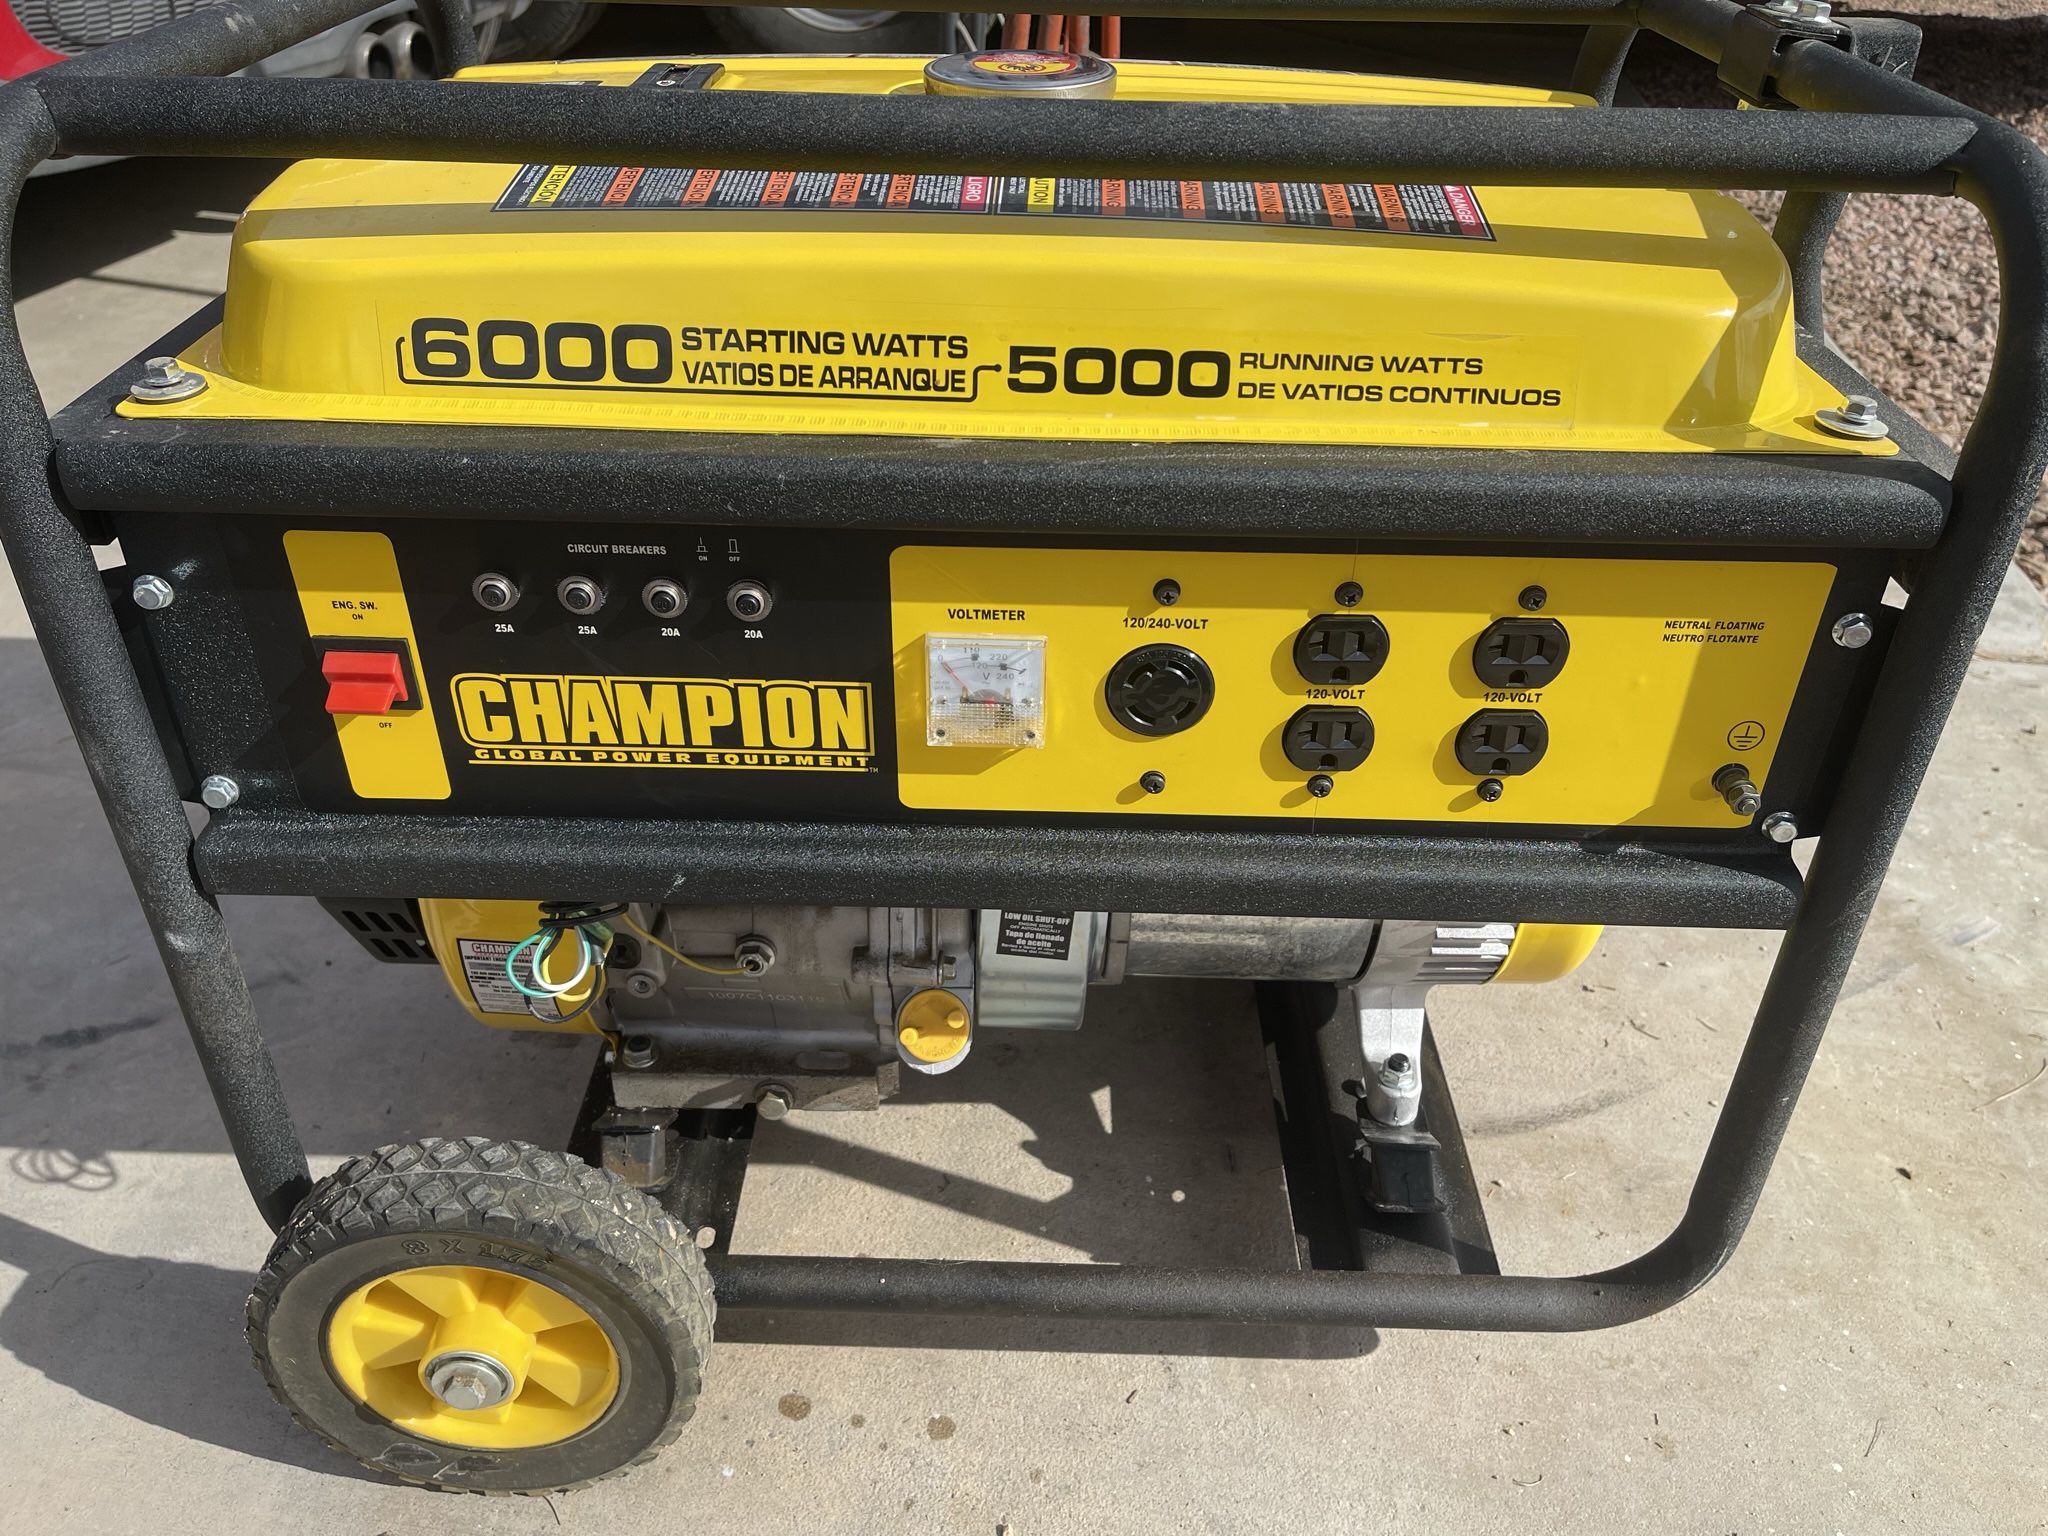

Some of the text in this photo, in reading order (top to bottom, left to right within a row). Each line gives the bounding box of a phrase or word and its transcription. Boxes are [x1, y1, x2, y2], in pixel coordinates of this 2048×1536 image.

[535, 165, 570, 202] TTENCIÓN
[605, 167, 640, 205] ERTENCIA
[687, 170, 715, 206] ERTENCIA
[767, 171, 789, 206] ERTENCIA
[965, 176, 981, 202] LIGRO
[1034, 179, 1049, 204] UTION
[1106, 179, 1121, 208] ARNING
[1183, 181, 1200, 211] ARNING
[1260, 183, 1279, 215] ARNING
[1379, 186, 1405, 223] WARNING
[1449, 191, 1477, 227] DANGER
[410, 317, 673, 385] 6000
[682, 327, 968, 359] STARTING WATTS
[1008, 346, 1230, 398] 5000
[1240, 353, 1482, 374] RUNNING WATTS
[682, 361, 965, 394] VATIOS DE ARRANQUE
[1238, 383, 1560, 406] DE VATIOS CONTINUOS
[567, 543, 666, 554] CIRCUIT BREAKERS
[332, 601, 378, 610] ENG. SW.
[948, 609, 1025, 620] VOLTMETER
[495, 624, 514, 632] 25A
[578, 626, 597, 634] 25A
[1123, 615, 1208, 629] 120/240-VOLT
[1665, 621, 1764, 630] NEUTRAL FLOATING
[661, 628, 680, 636] 20A
[745, 630, 763, 638] 20A
[1663, 634, 1759, 643] NEUTRO FLOTANTE
[990, 652, 1009, 662] 220
[982, 672, 991, 681] V
[1303, 686, 1365, 699] 120-VOLT
[1481, 690, 1542, 703] 120-VOLT
[456, 680, 868, 750] CHAMPION
[475, 749, 870, 767] GLOBAL POWER EQUIPMENT
[1004, 912, 1071, 926] LOW OIL SHUT-OFF
[1005, 929, 1024, 938] Tapa
[1024, 931, 1035, 939] de
[473, 943, 532, 955] CHAMPN
[401, 1239, 431, 1256] 8
[439, 1238, 466, 1254] X
